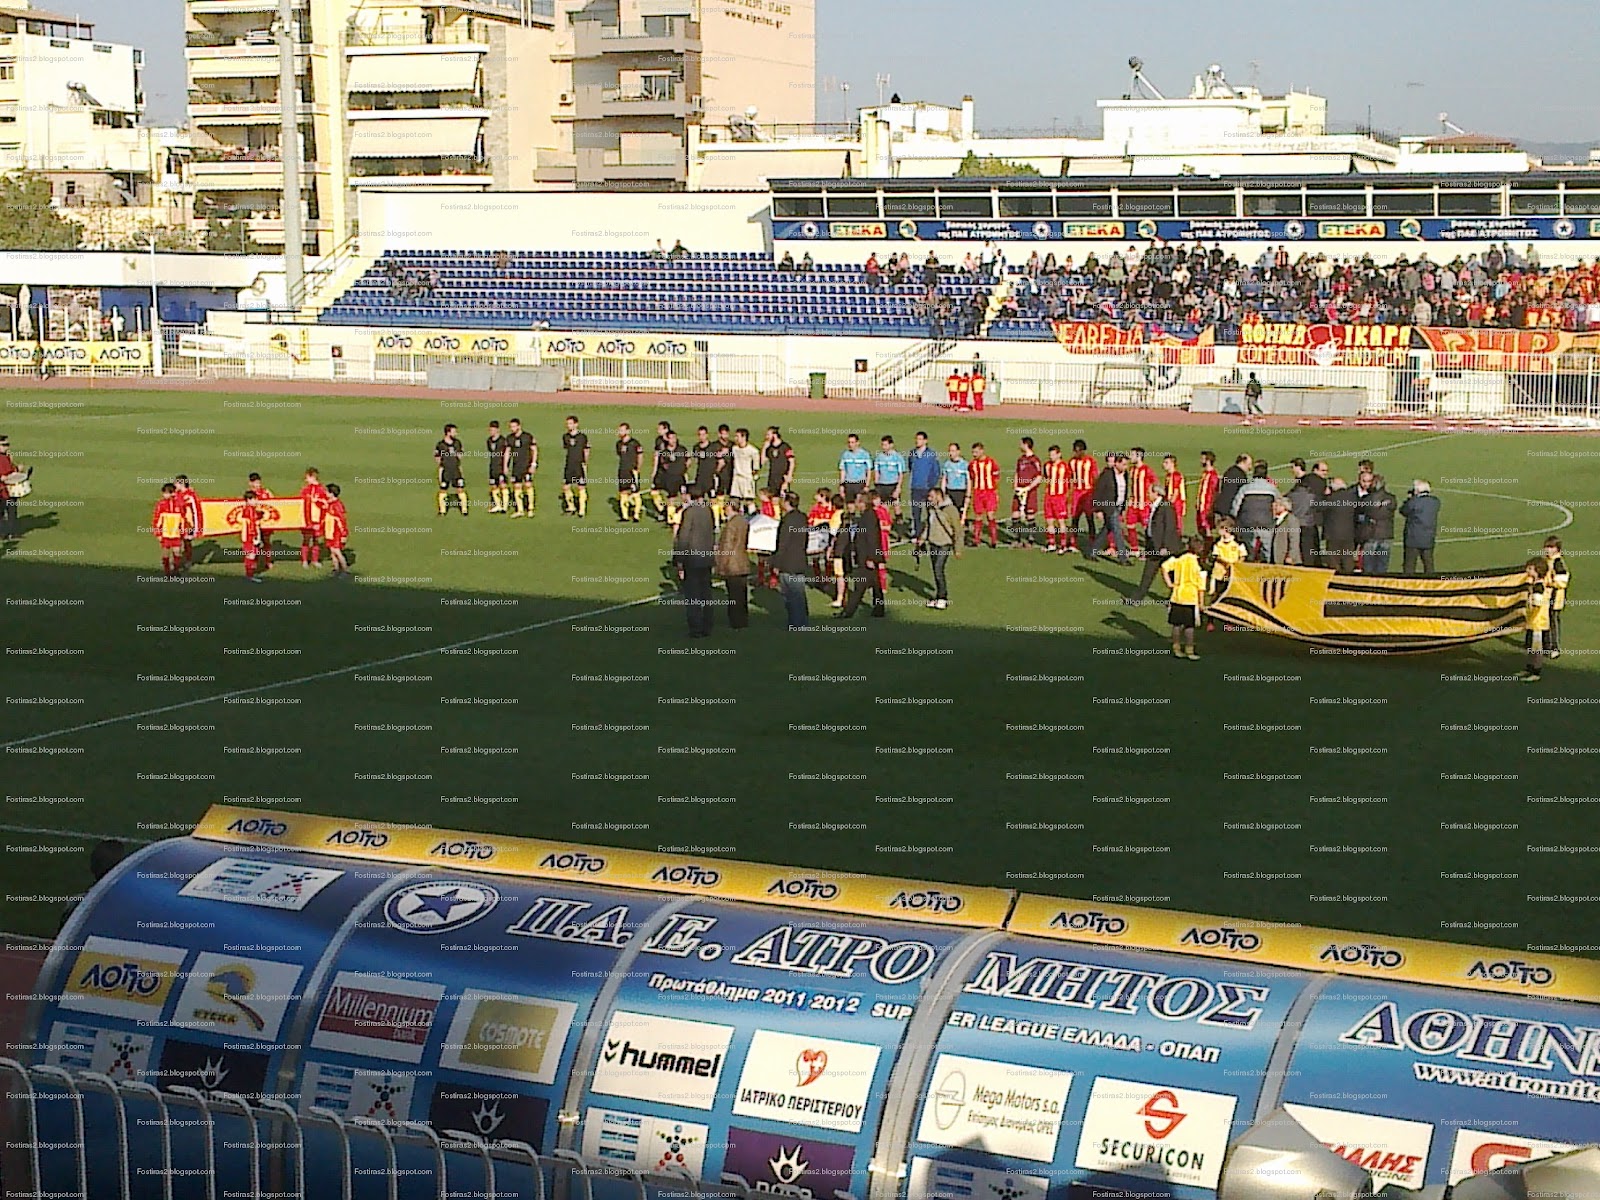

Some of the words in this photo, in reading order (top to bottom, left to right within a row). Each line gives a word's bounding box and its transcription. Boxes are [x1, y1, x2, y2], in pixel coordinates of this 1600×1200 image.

[328, 986, 433, 1023] Millennium
[648, 973, 760, 1003] Πρωτάθλημα
[763, 988, 806, 1008] 2011
[810, 993, 860, 1013] 2012
[978, 1013, 1064, 1040] LEAGUE
[963, 951, 1270, 1031] ΜΗΤΟΣ
[619, 1041, 722, 1079] hummel
[741, 1087, 786, 1109] ΙΑΤΡΙΚΟ
[789, 1094, 863, 1120] ΠΕΡΙΣΤΕΡΙΟΥ
[973, 1084, 1004, 1110] Mega
[1004, 1089, 1041, 1112] Motors
[1100, 1137, 1205, 1170] SECURICON
